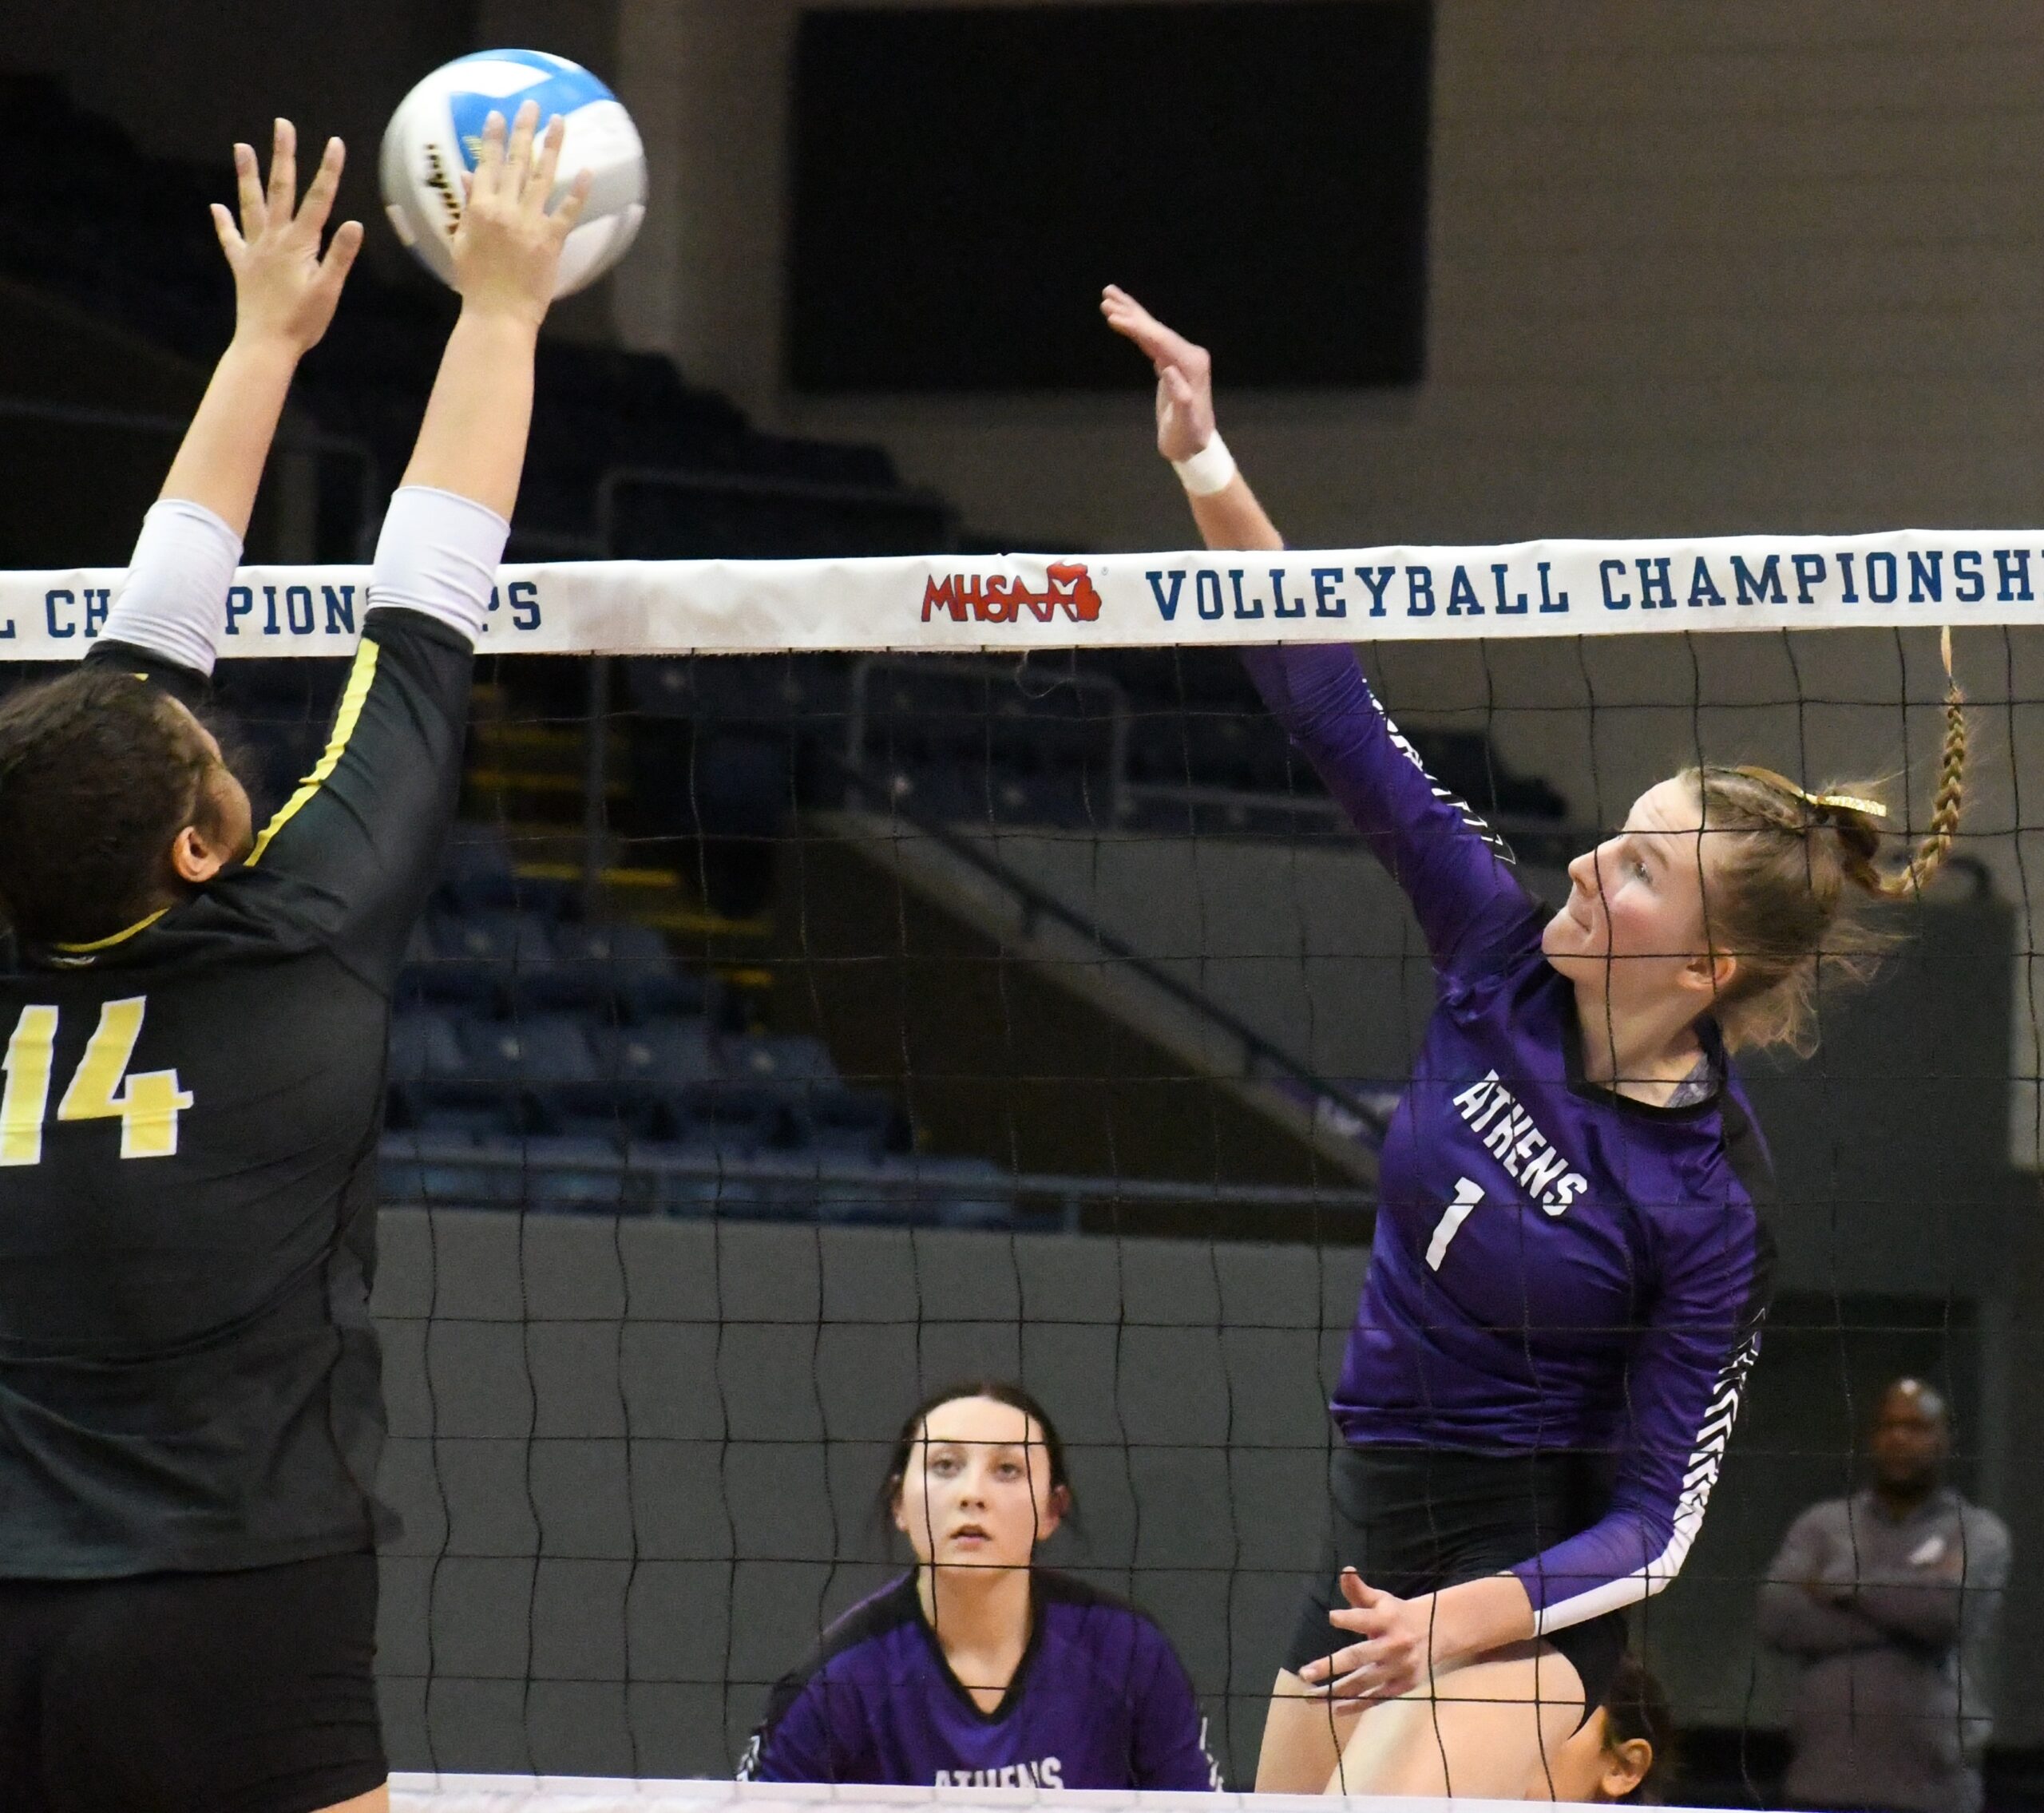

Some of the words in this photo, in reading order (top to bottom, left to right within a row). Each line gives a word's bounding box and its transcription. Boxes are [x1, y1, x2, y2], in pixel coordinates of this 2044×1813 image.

[46, 581, 541, 638] CHPIONS
[921, 569, 1086, 623] MHSAA
[1145, 562, 1569, 621] VOLLEYBALL
[1599, 549, 2044, 610] CHAMPIONSH
[0, 995, 194, 1166] 14
[1452, 1068, 1587, 1216] ATHENS
[1425, 1177, 1485, 1271] 1
